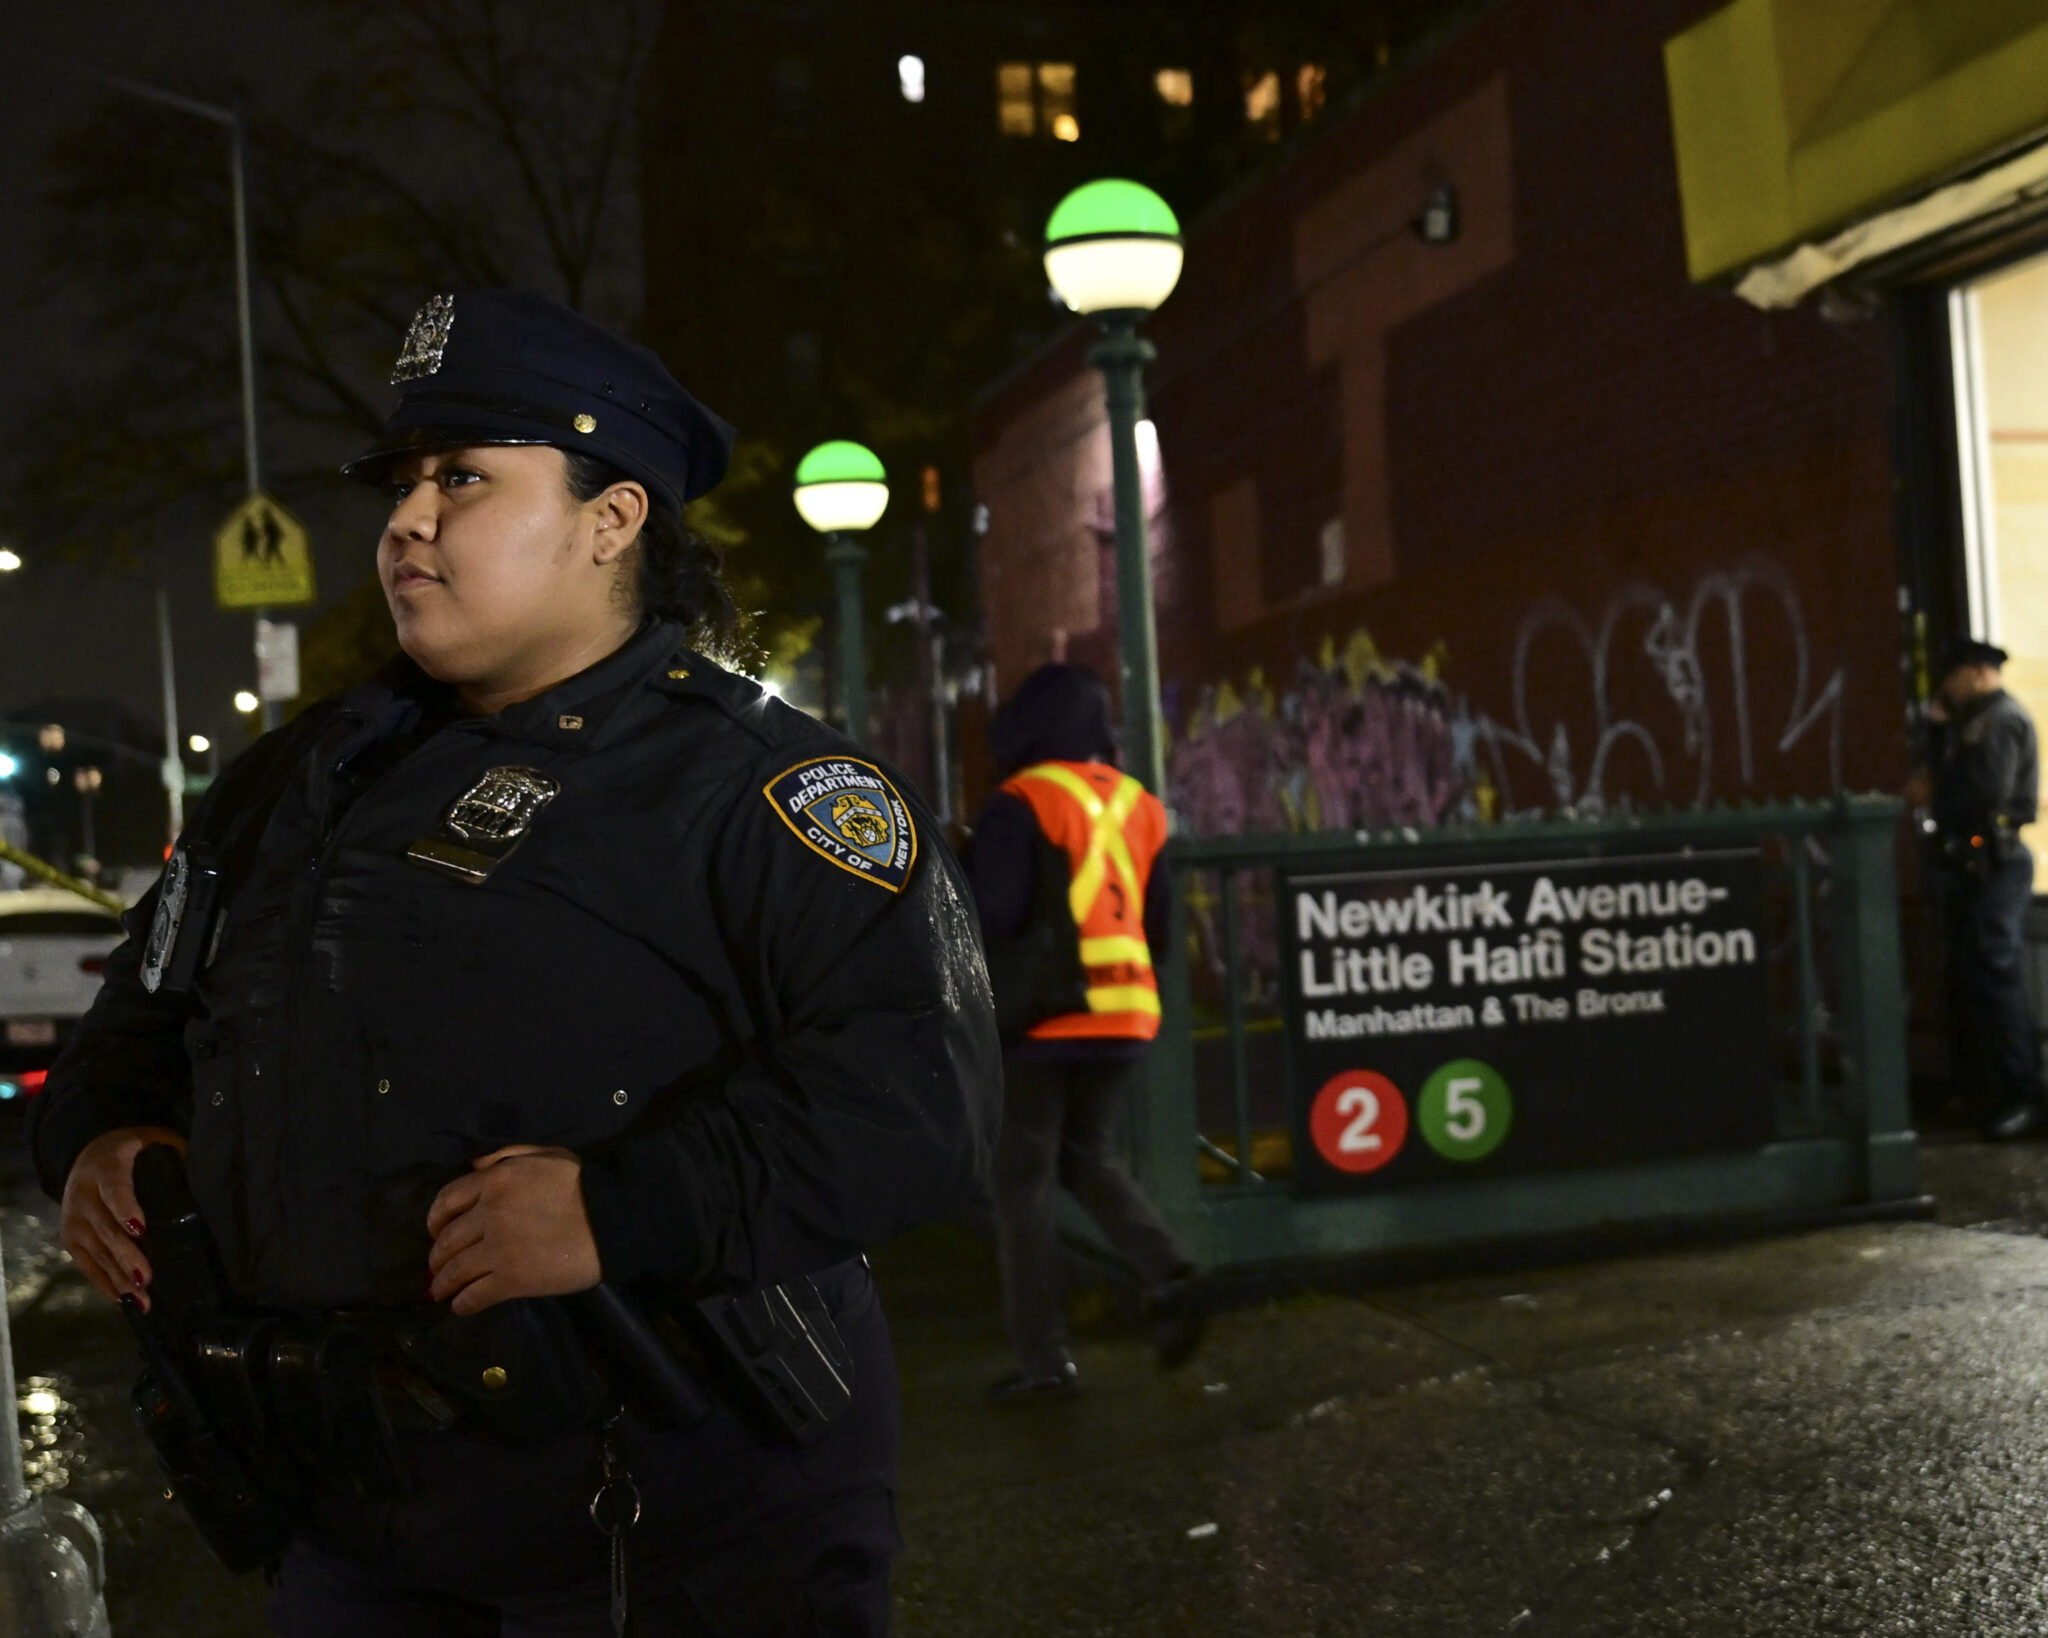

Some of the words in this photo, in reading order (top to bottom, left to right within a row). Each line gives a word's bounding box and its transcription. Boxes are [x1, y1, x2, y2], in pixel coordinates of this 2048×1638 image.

[789, 774, 885, 814] DEPARTMENT
[799, 763, 858, 786] POLICE
[890, 799, 910, 836] YORK
[806, 826, 846, 856] CITY
[847, 854, 873, 871] OF
[894, 838, 909, 871] NEW
[1297, 881, 1512, 941] Newkirk
[1525, 876, 1729, 926] Avenue-
[1300, 944, 1434, 997] Little
[1580, 922, 1756, 976] Station
[1305, 1002, 1474, 1041] Manhattan
[1480, 996, 1504, 1026] &
[1511, 993, 1569, 1023] The
[1576, 986, 1665, 1017] Bronx
[1335, 1087, 1382, 1152] 2
[1445, 1077, 1486, 1140] 5
